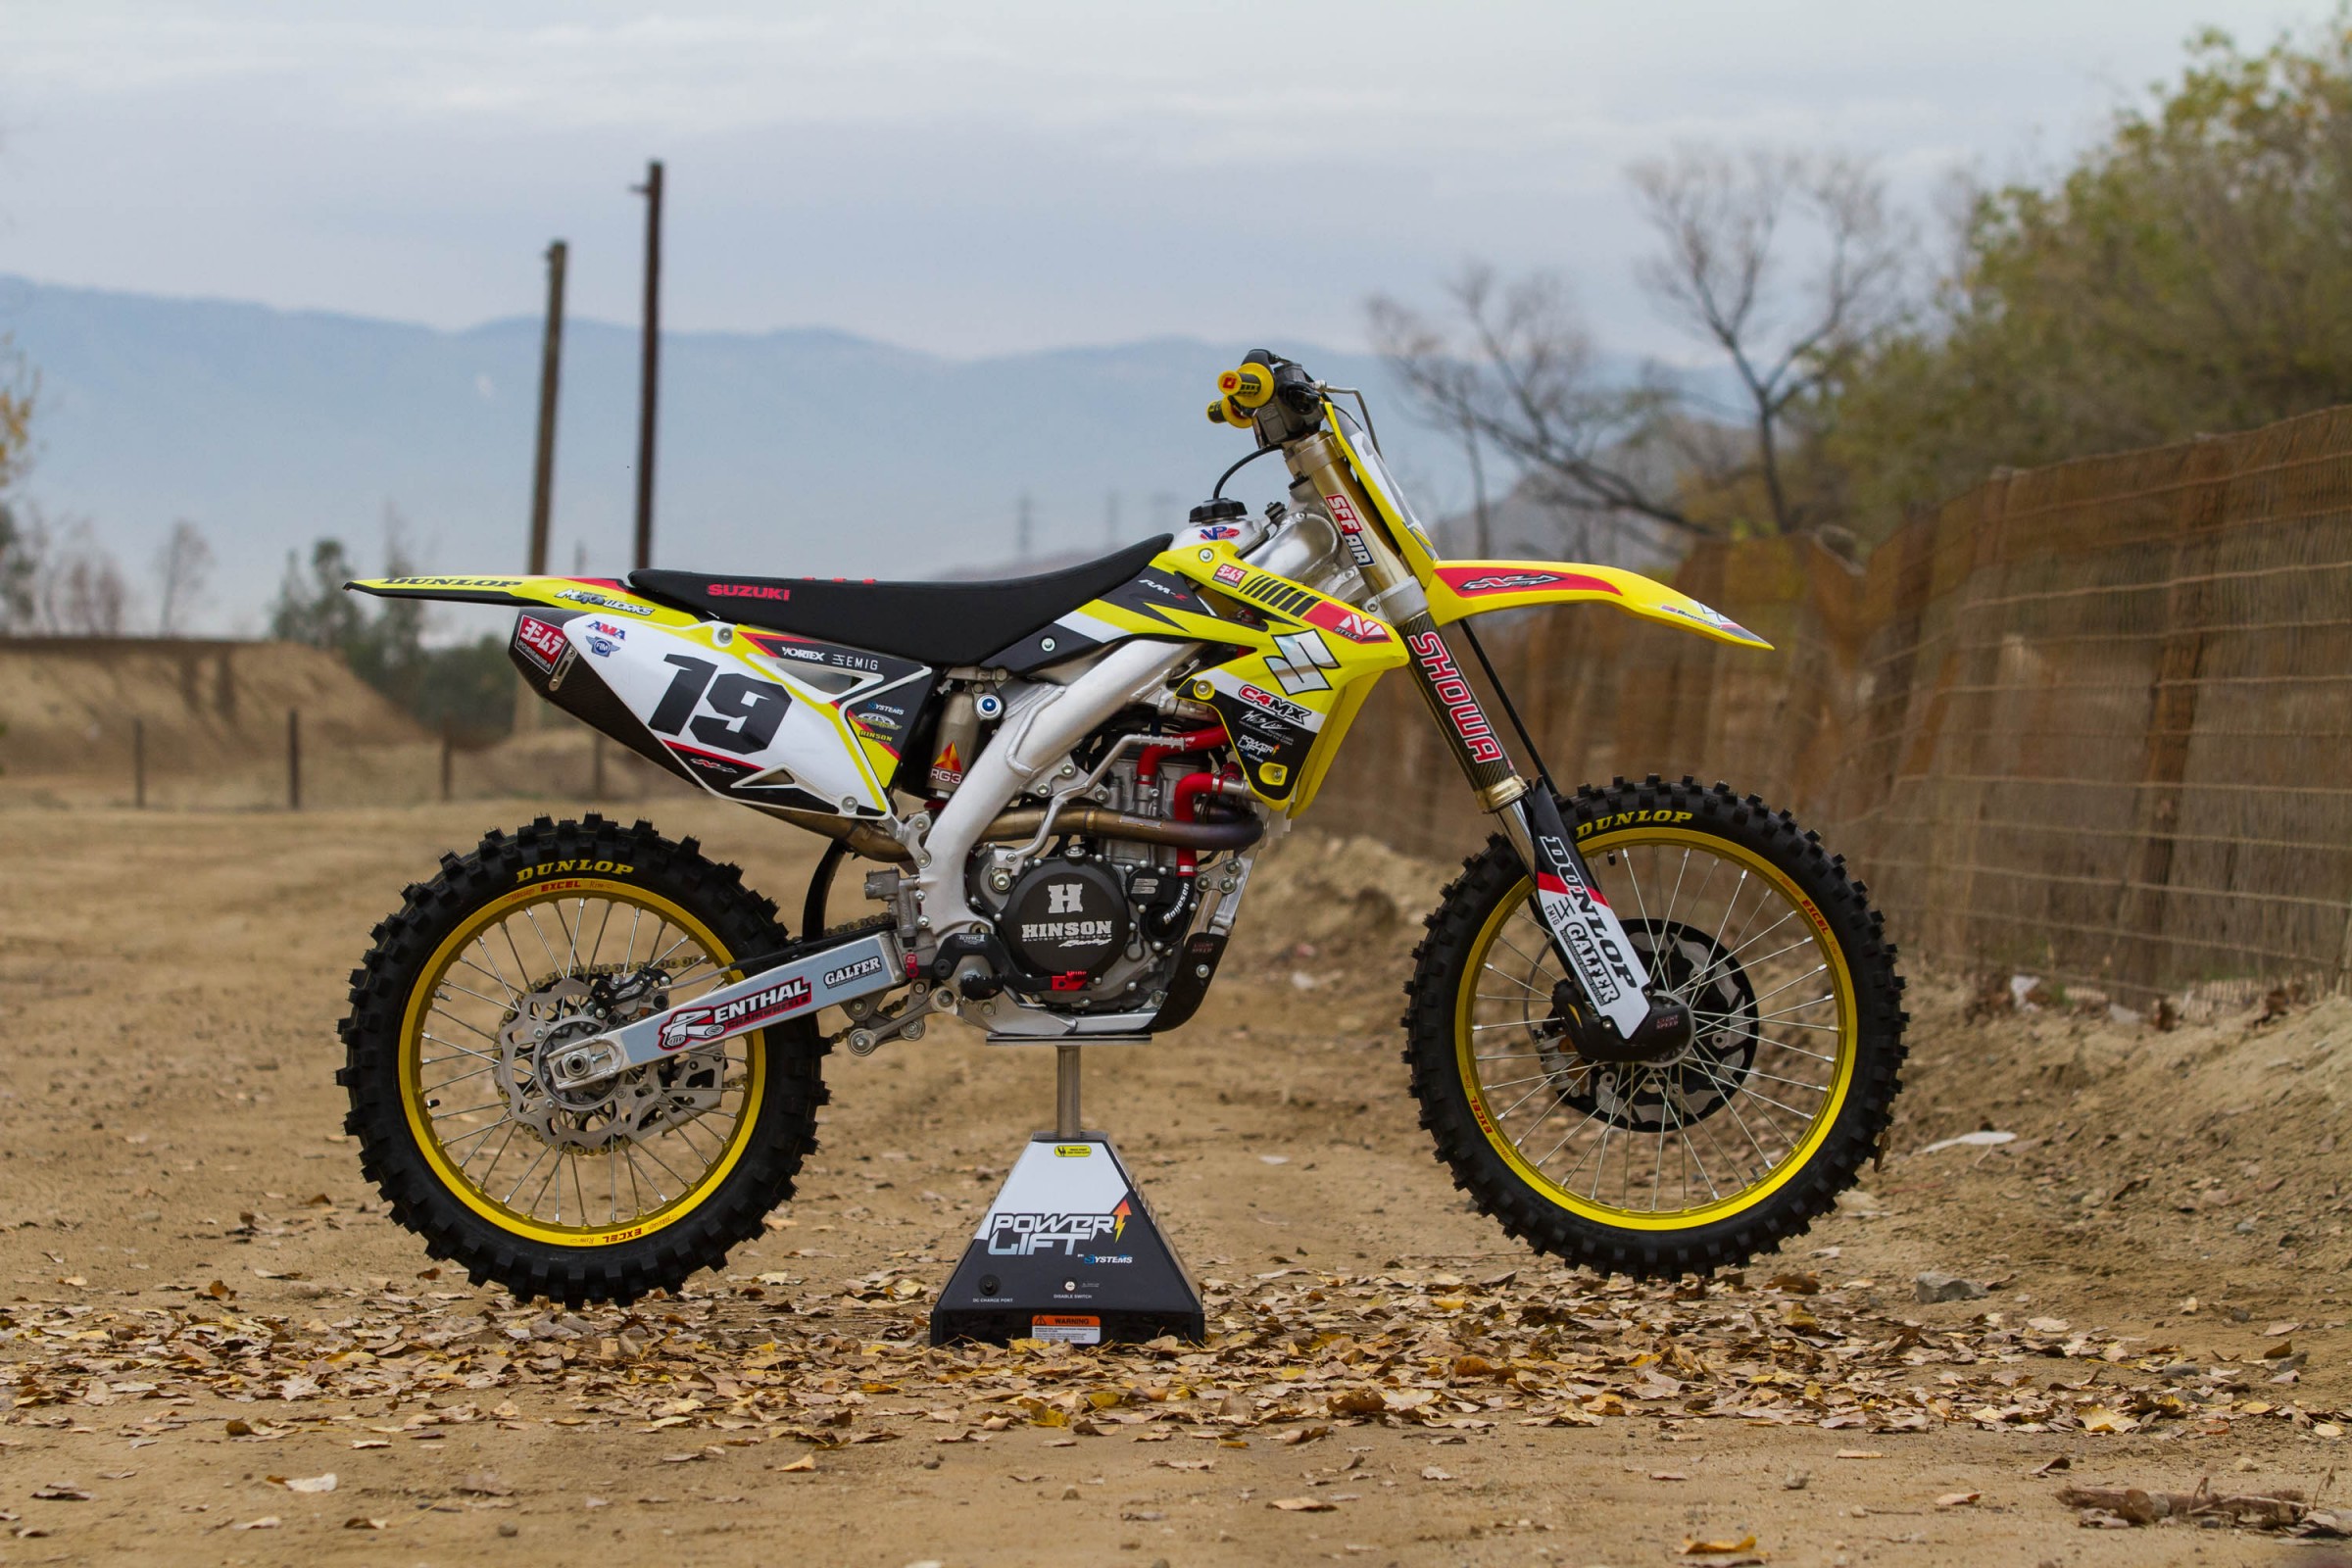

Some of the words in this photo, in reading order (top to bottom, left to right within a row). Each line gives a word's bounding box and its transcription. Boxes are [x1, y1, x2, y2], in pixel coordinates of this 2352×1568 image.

[1200, 526, 1227, 540] VP
[1327, 494, 1362, 534] SFF
[1346, 533, 1374, 565] AIR
[380, 577, 522, 587] DUNLOP
[708, 584, 790, 601] SUZUKI
[587, 620, 626, 640] AMA
[1334, 627, 1360, 640] STYLE
[782, 646, 824, 662] VORTEX
[846, 656, 878, 670] EMIG
[648, 654, 793, 755] 19
[1240, 685, 1310, 723] C4MX
[1407, 630, 1503, 764] SHOWA
[931, 768, 961, 784] RG3
[1576, 809, 1693, 839] DUNLOP
[516, 858, 634, 883] DUNLOP
[540, 880, 581, 892] EXCEL
[1048, 883, 1083, 913] H
[1163, 882, 1190, 925] Boyesen
[1540, 835, 1638, 989] DUNLOP
[1545, 905, 1560, 926] EMIG
[1021, 920, 1112, 938] HINSON
[1802, 899, 1829, 935] EXCEL
[824, 956, 881, 986] GALFER
[1565, 922, 1620, 1005] GALFER
[1471, 1096, 1493, 1134] EXCEL
[602, 1227, 642, 1243] EXCEL
[993, 1215, 1115, 1241] POWER
[988, 1230, 1090, 1255] LIFT
